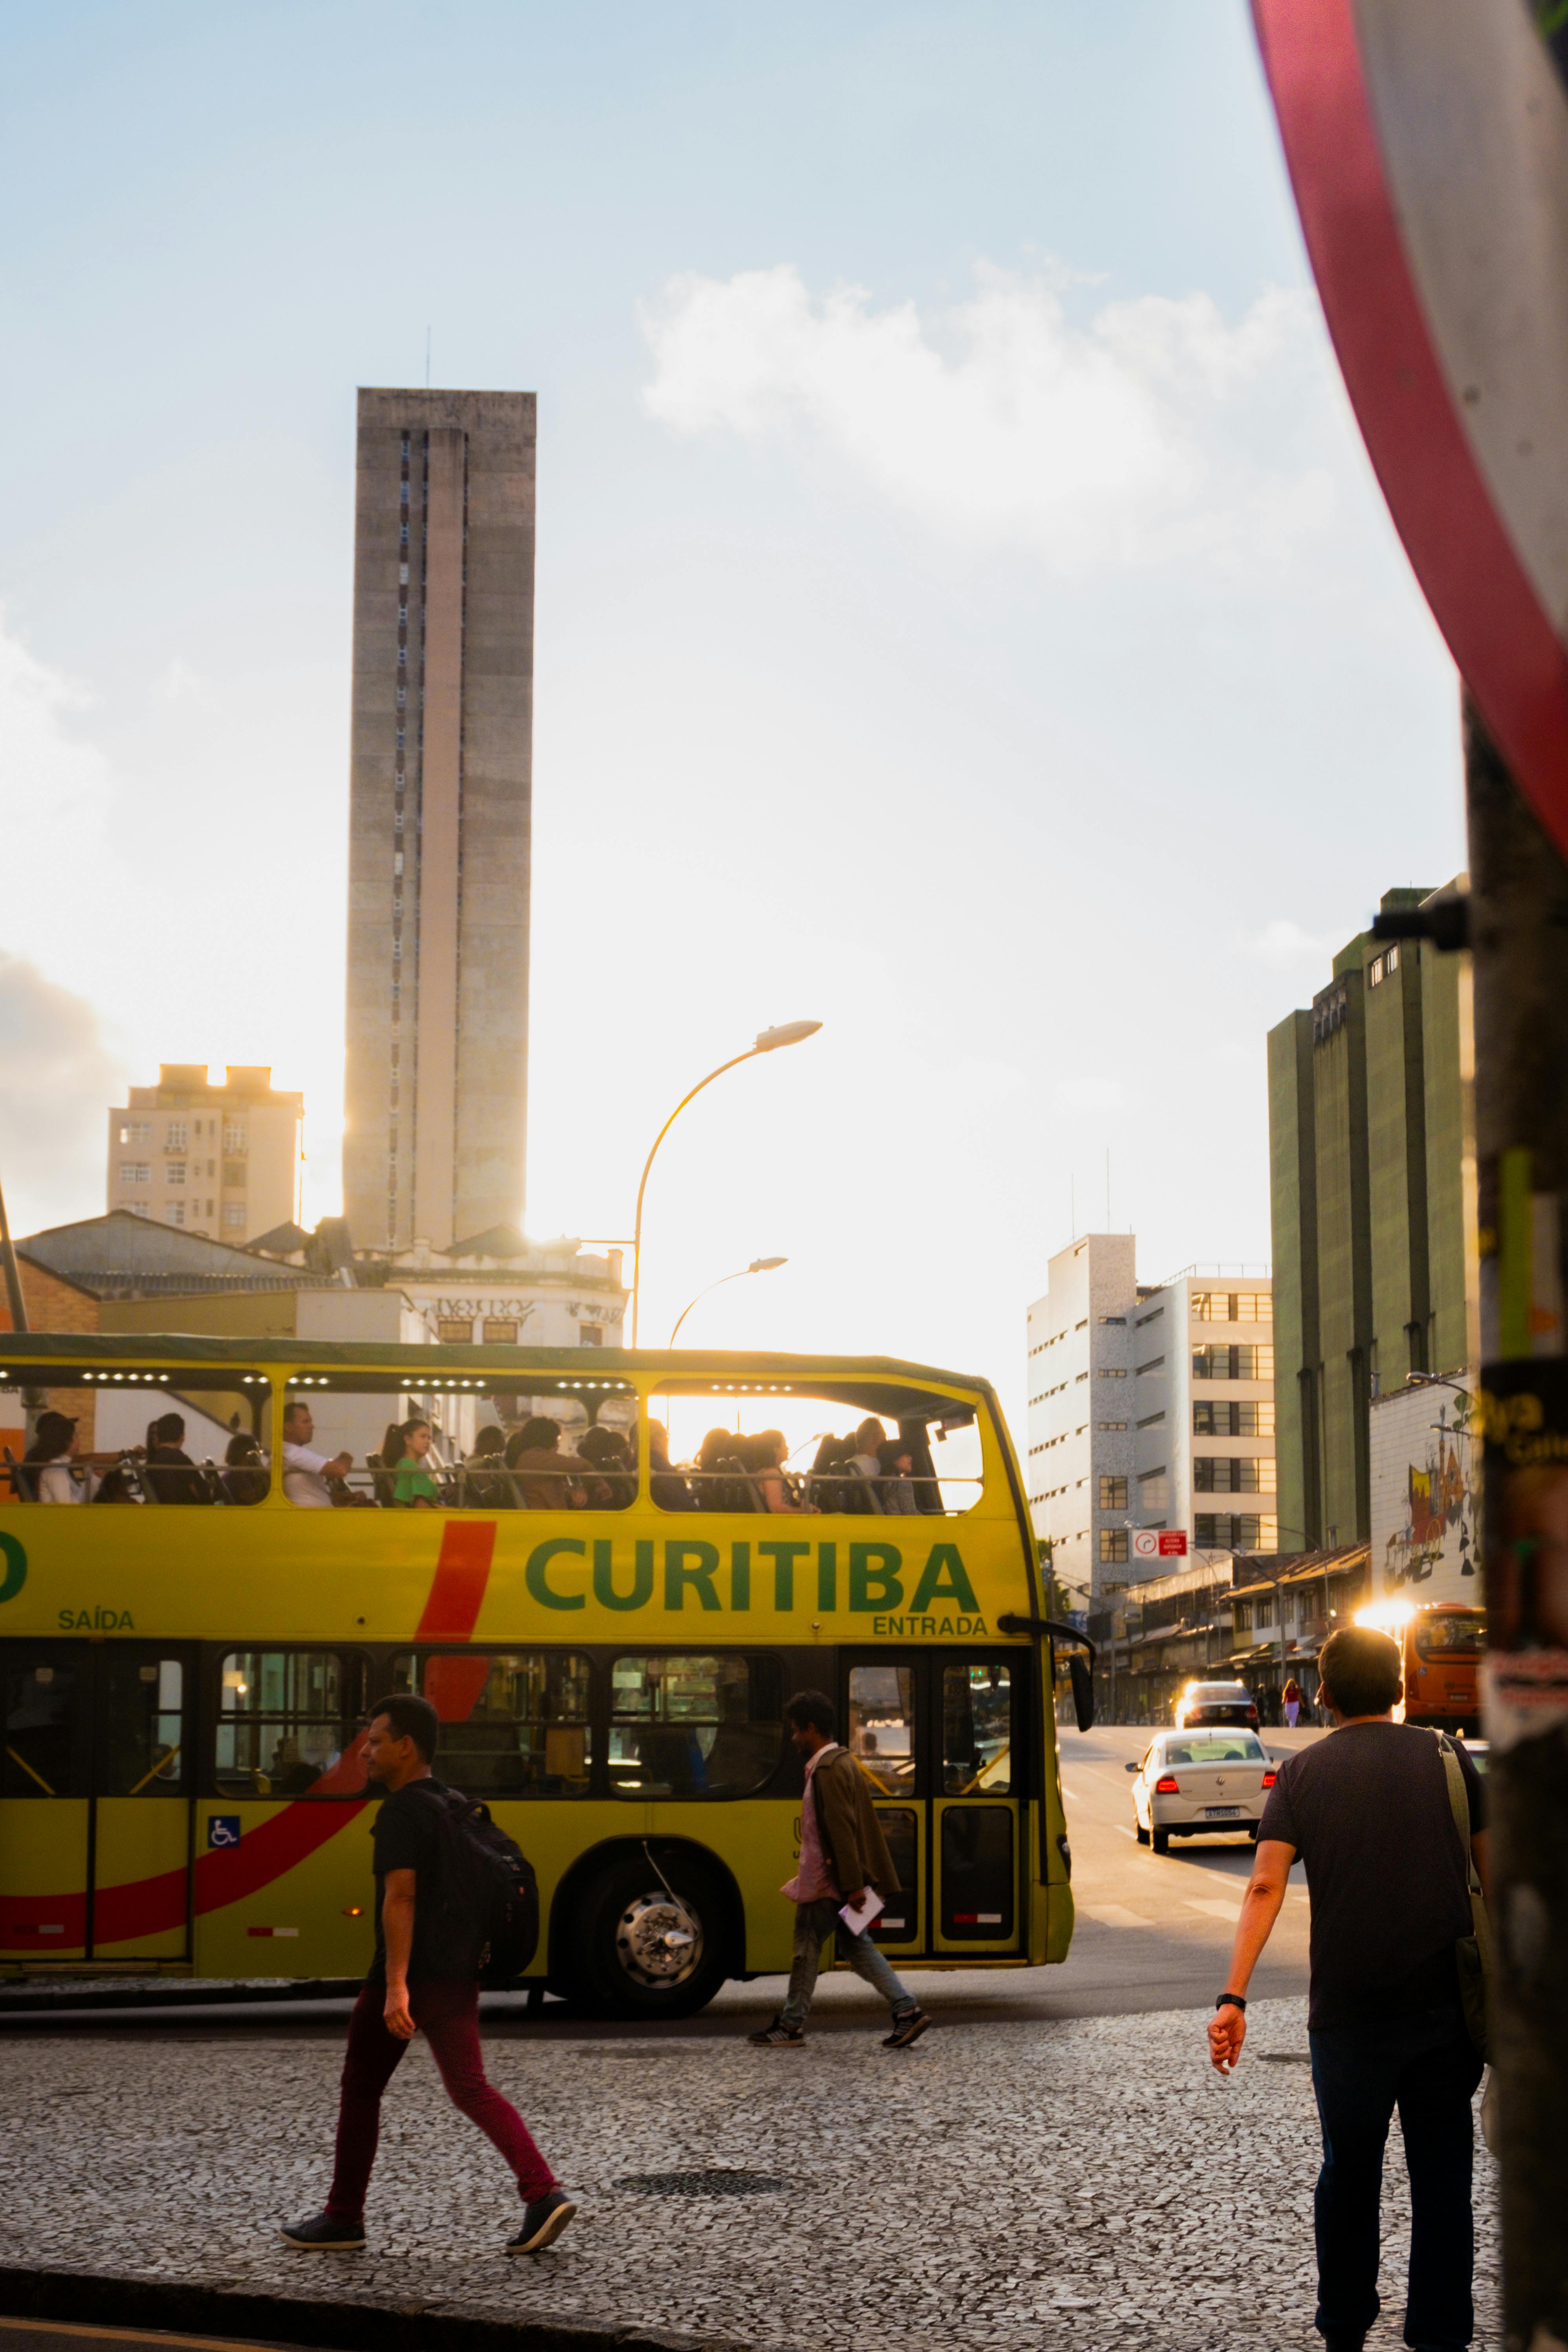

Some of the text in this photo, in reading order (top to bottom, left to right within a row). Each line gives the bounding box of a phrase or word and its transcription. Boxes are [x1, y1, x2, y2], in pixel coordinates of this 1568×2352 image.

[525, 1537, 980, 1613] CURITIBA
[58, 1605, 134, 1630] SAÍDA
[873, 1617, 988, 1635] ENTRADA
